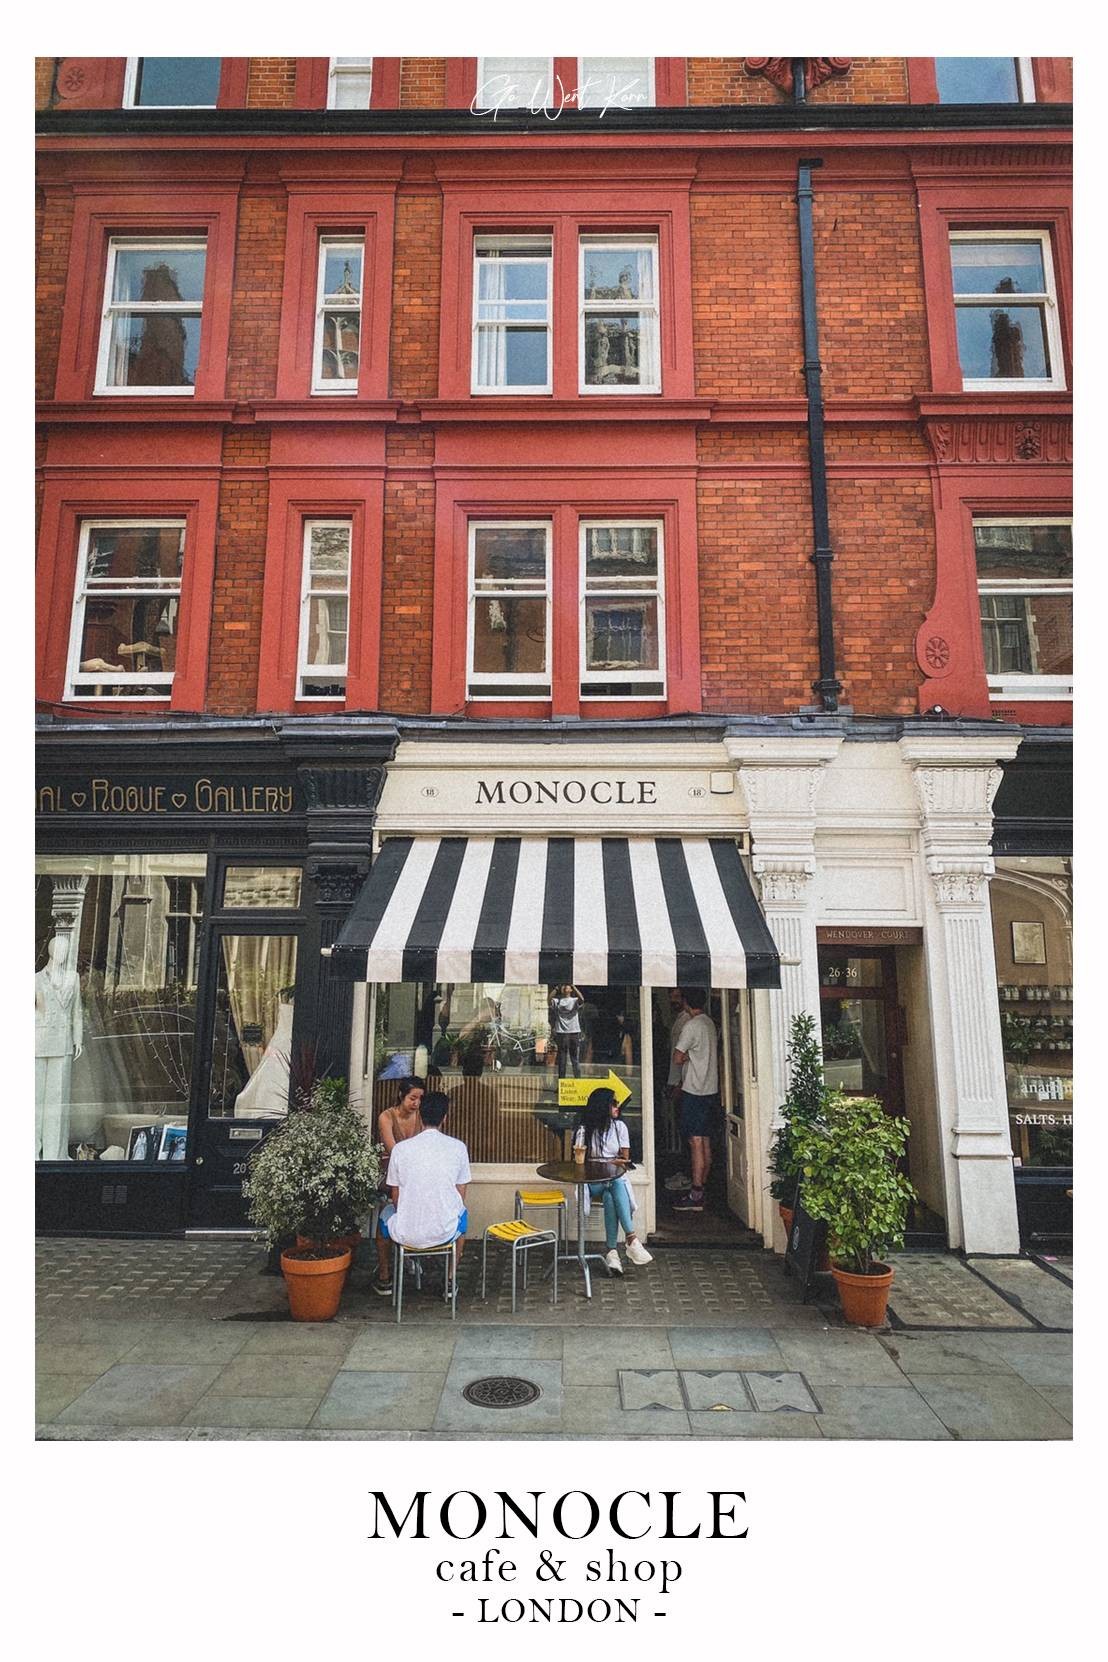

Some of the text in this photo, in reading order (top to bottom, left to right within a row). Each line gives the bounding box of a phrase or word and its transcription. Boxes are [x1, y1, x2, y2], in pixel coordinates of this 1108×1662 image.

[35, 779, 293, 813] AL ROGUE GALLERY
[474, 780, 658, 804] MONOCLE
